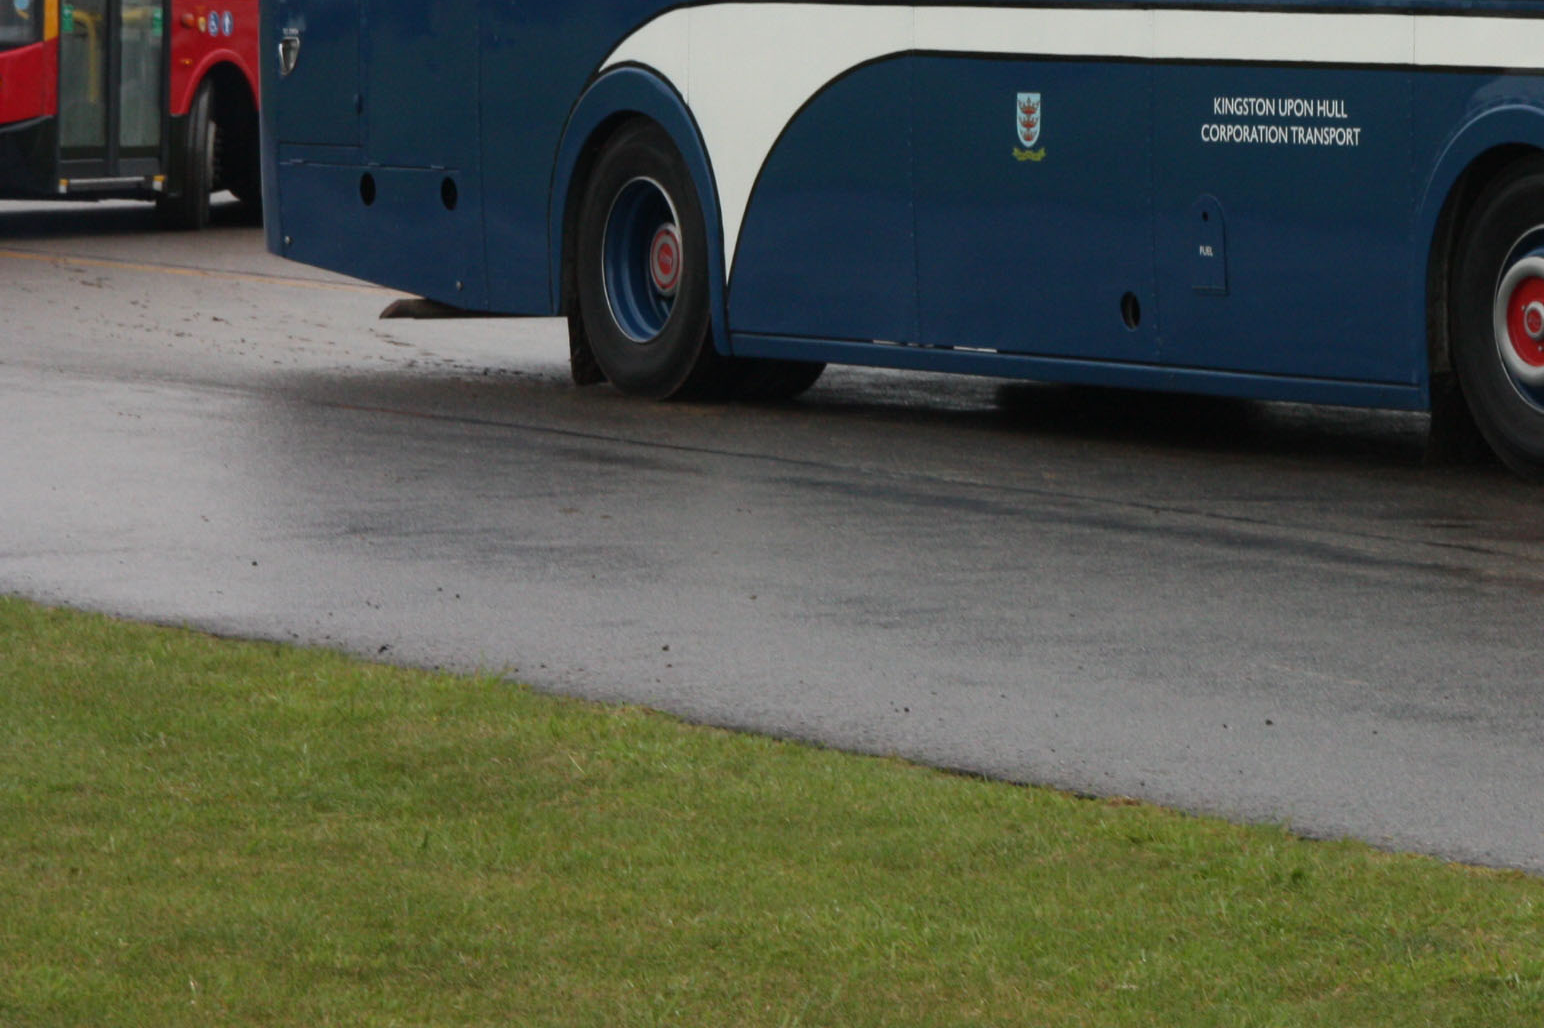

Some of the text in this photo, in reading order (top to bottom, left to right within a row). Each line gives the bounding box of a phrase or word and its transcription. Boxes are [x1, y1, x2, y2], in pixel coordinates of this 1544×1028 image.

[1213, 97, 1348, 119] KINGSTON UPON HULL
[1201, 124, 1361, 146] CORPORATION TRANSPORT
